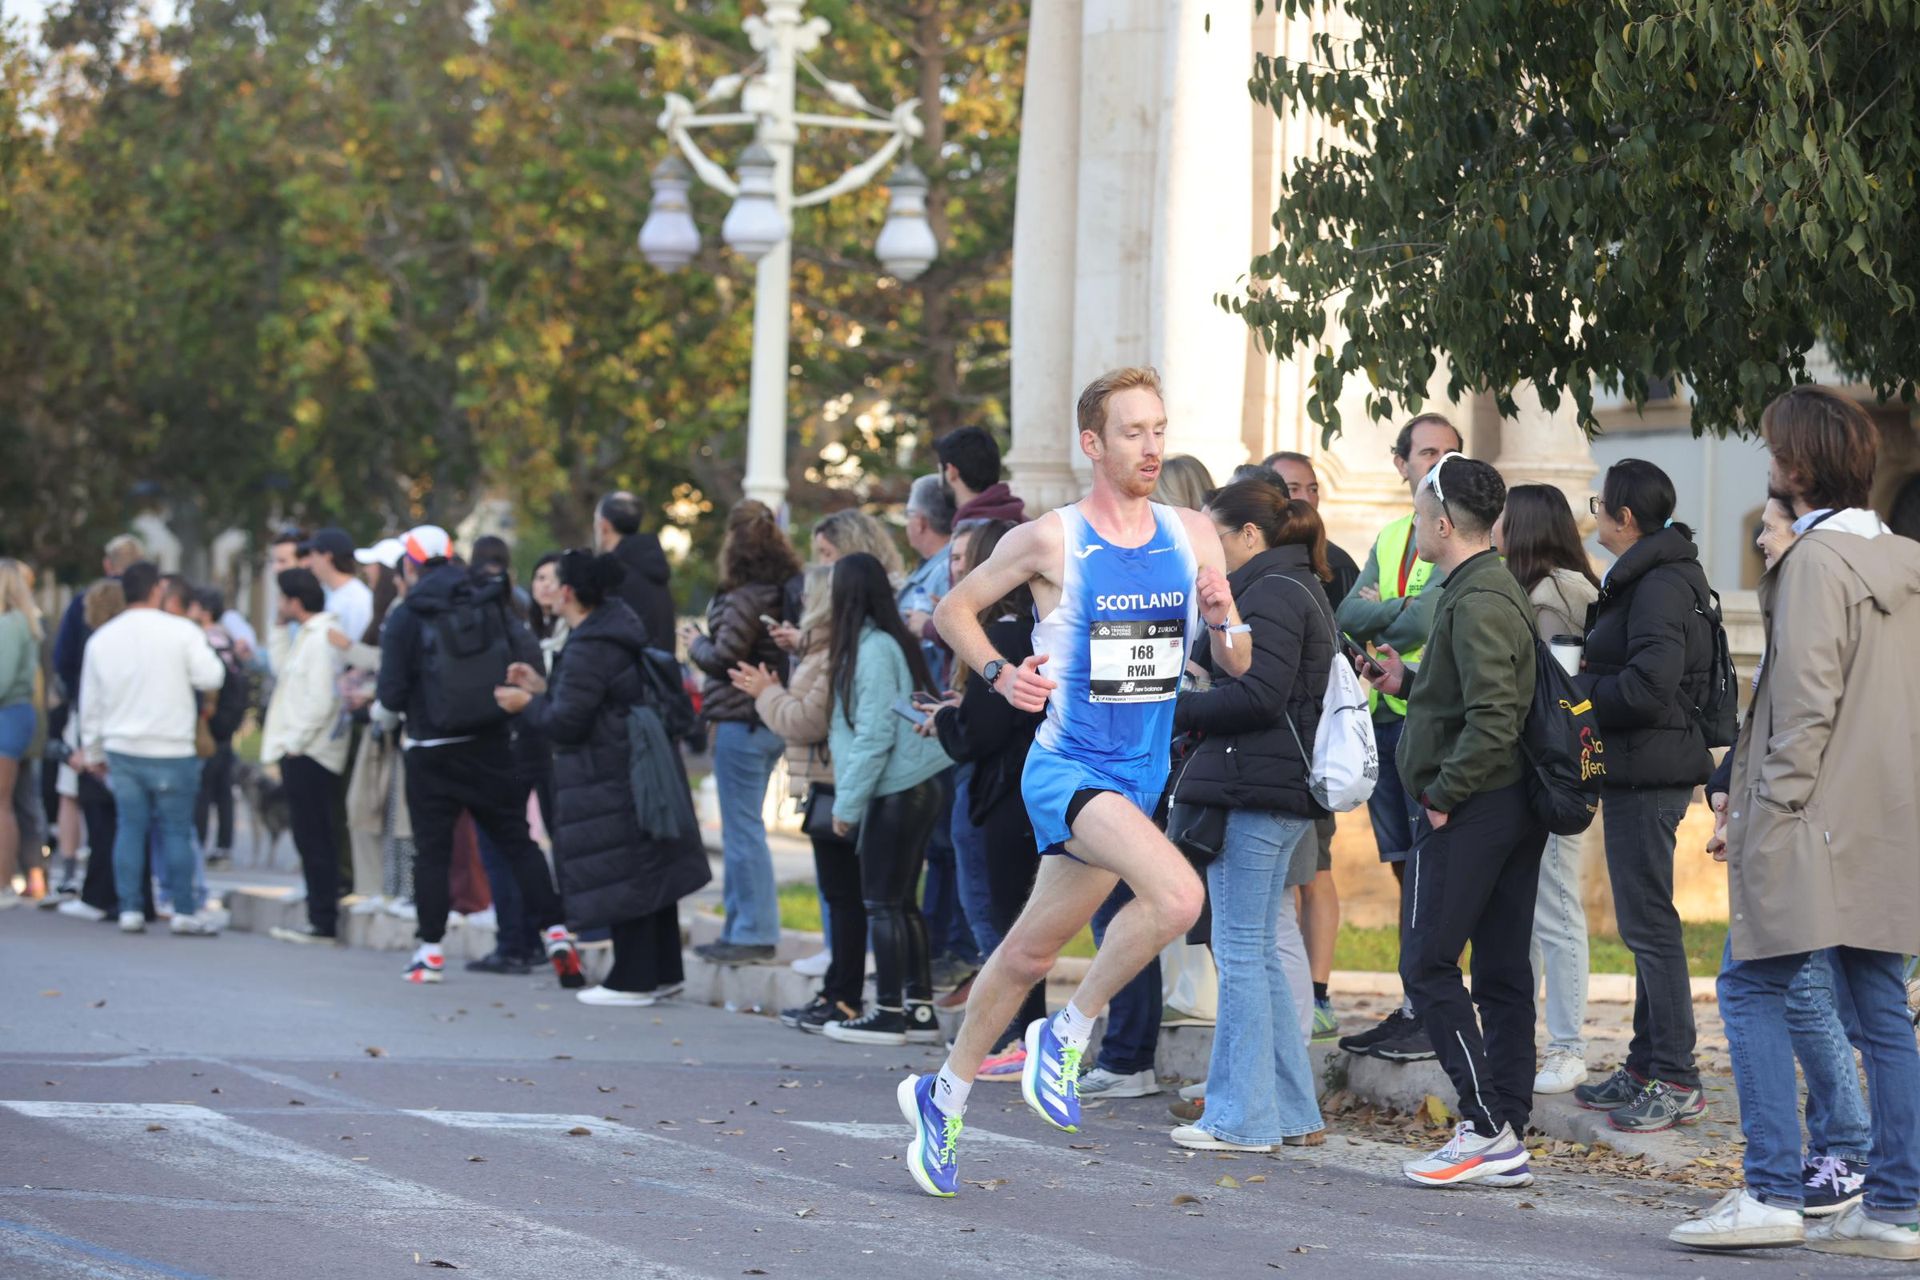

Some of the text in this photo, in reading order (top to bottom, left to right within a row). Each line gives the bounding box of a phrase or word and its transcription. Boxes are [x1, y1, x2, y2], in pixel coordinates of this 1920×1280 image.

[1096, 591, 1184, 611] SCOTLAND
[1130, 645, 1154, 660] 168
[1127, 665, 1155, 677] RYAN
